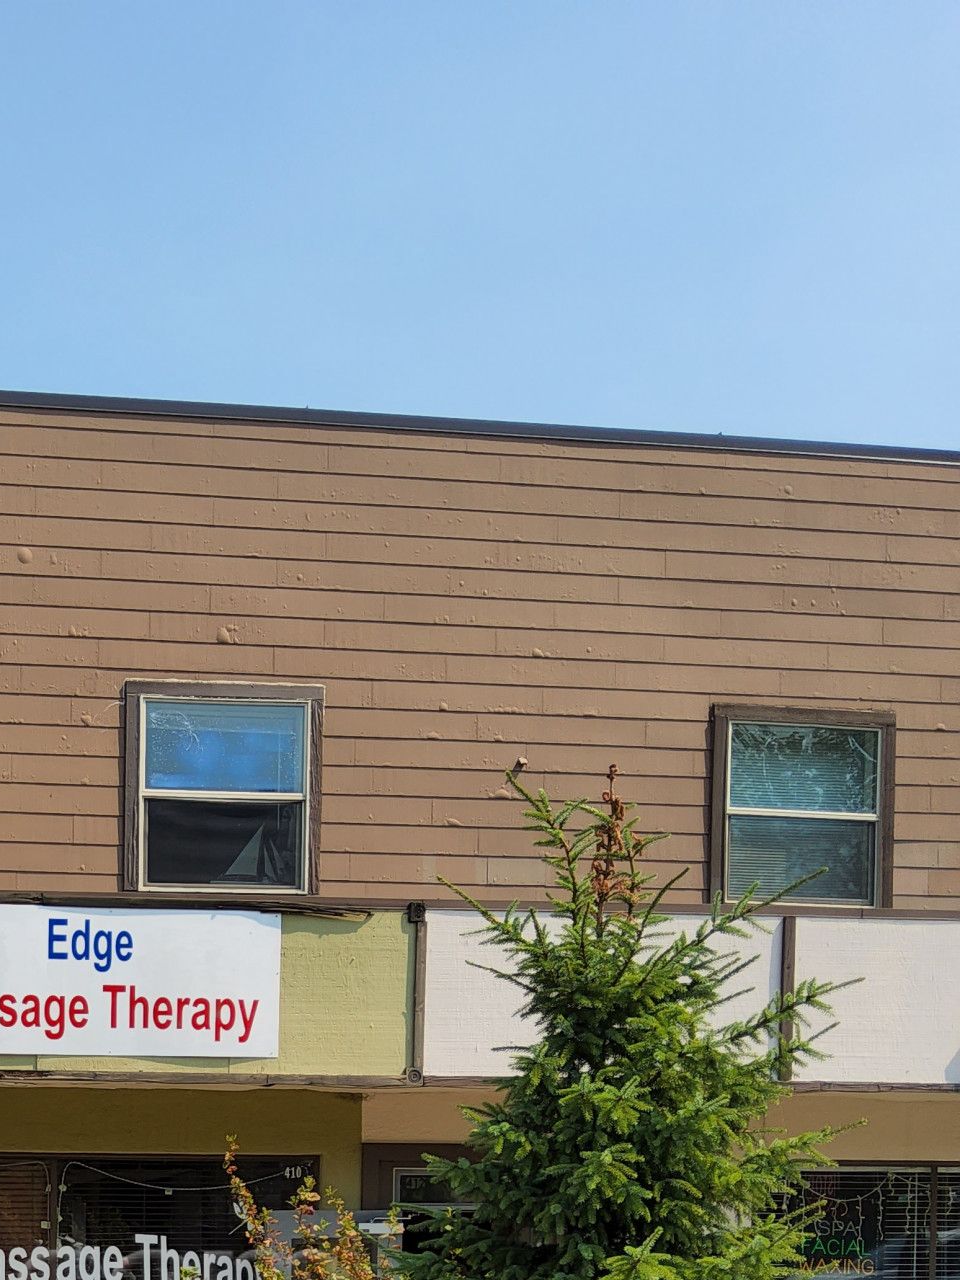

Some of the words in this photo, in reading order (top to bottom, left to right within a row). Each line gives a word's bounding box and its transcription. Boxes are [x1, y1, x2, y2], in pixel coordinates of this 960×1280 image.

[48, 917, 133, 972] Edge
[103, 984, 259, 1043] Therapy
[284, 1166, 302, 1179] 410
[819, 1220, 858, 1236] SPA
[801, 1238, 871, 1256] FACIAL
[800, 1258, 874, 1275] WAXING
